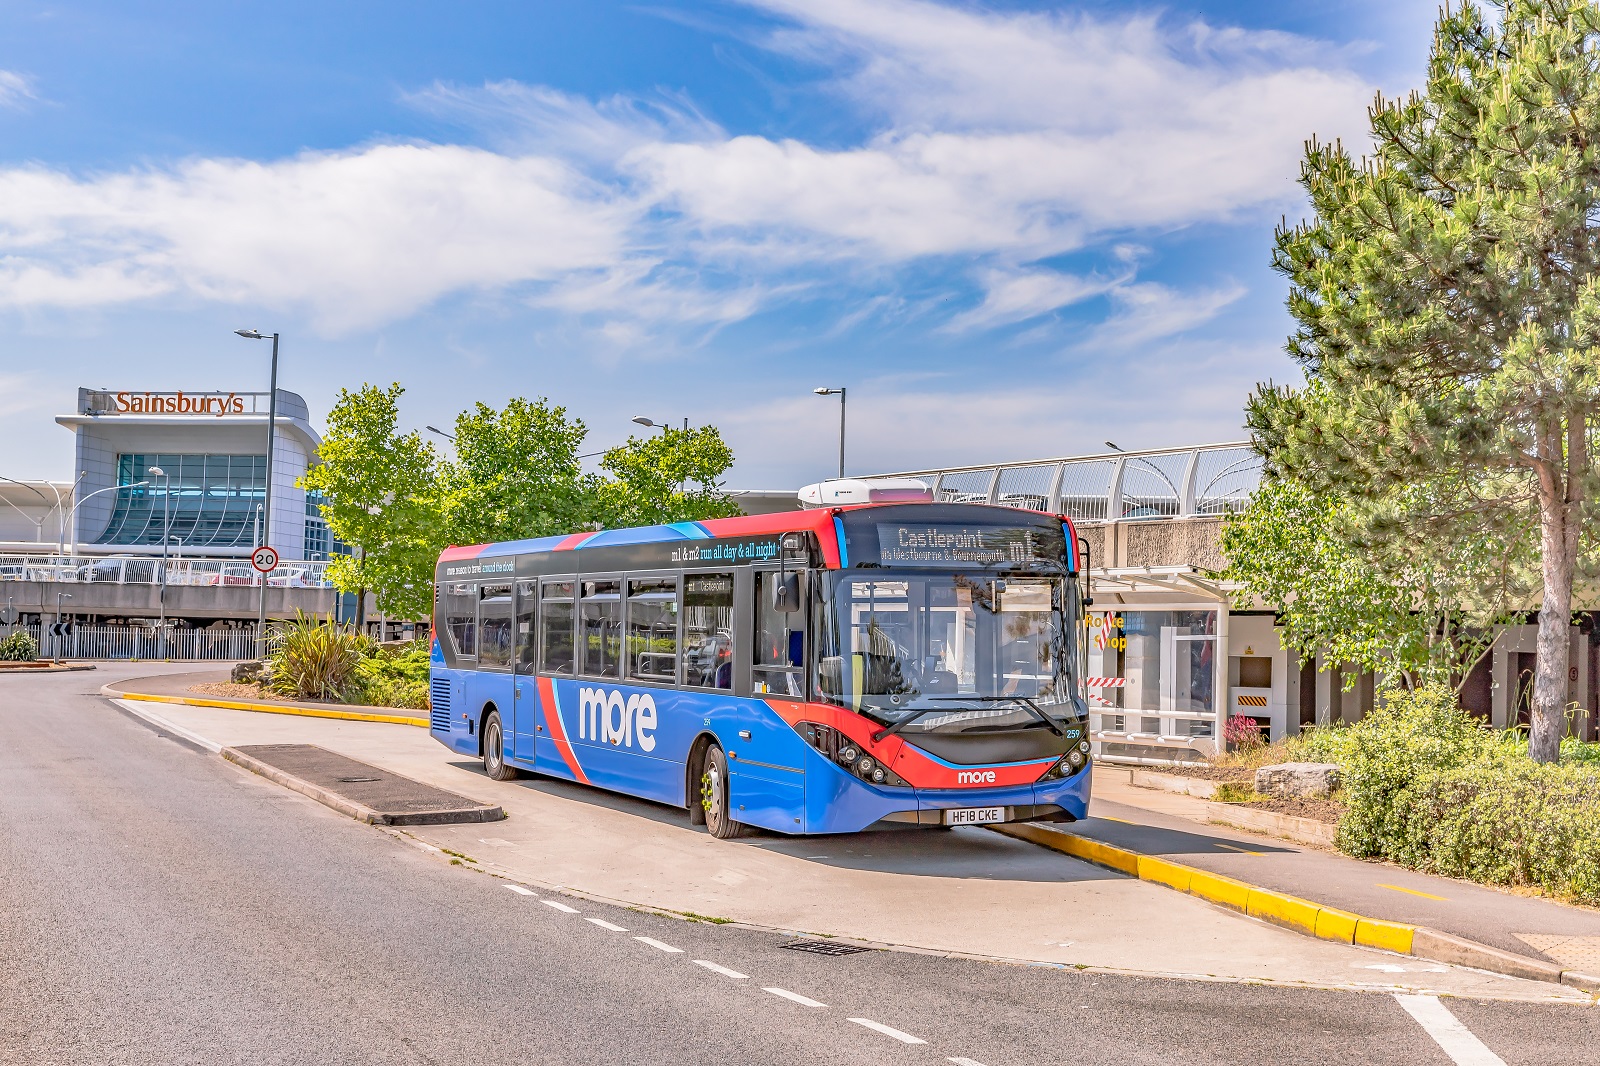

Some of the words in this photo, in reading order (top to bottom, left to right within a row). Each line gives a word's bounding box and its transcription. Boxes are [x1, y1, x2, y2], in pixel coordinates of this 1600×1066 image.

[117, 392, 244, 417] Sainsbury's
[898, 528, 984, 548] Castlepoint
[671, 548, 681, 561] m1
[682, 547, 689, 561] &
[689, 546, 700, 560] m2
[700, 549, 713, 560] run
[713, 545, 722, 559] all
[723, 544, 737, 562] day
[738, 543, 745, 558] &
[745, 542, 755, 558] all
[755, 541, 776, 560] night
[893, 548, 942, 561] Westbourne
[944, 548, 951, 561] &
[952, 549, 1005, 562] Bournemouth
[255, 554, 274, 565] 20
[579, 687, 658, 752] more
[1066, 729, 1080, 739] 259
[957, 770, 996, 784] more
[952, 811, 976, 823] HF18
[978, 809, 998, 821] CKE
